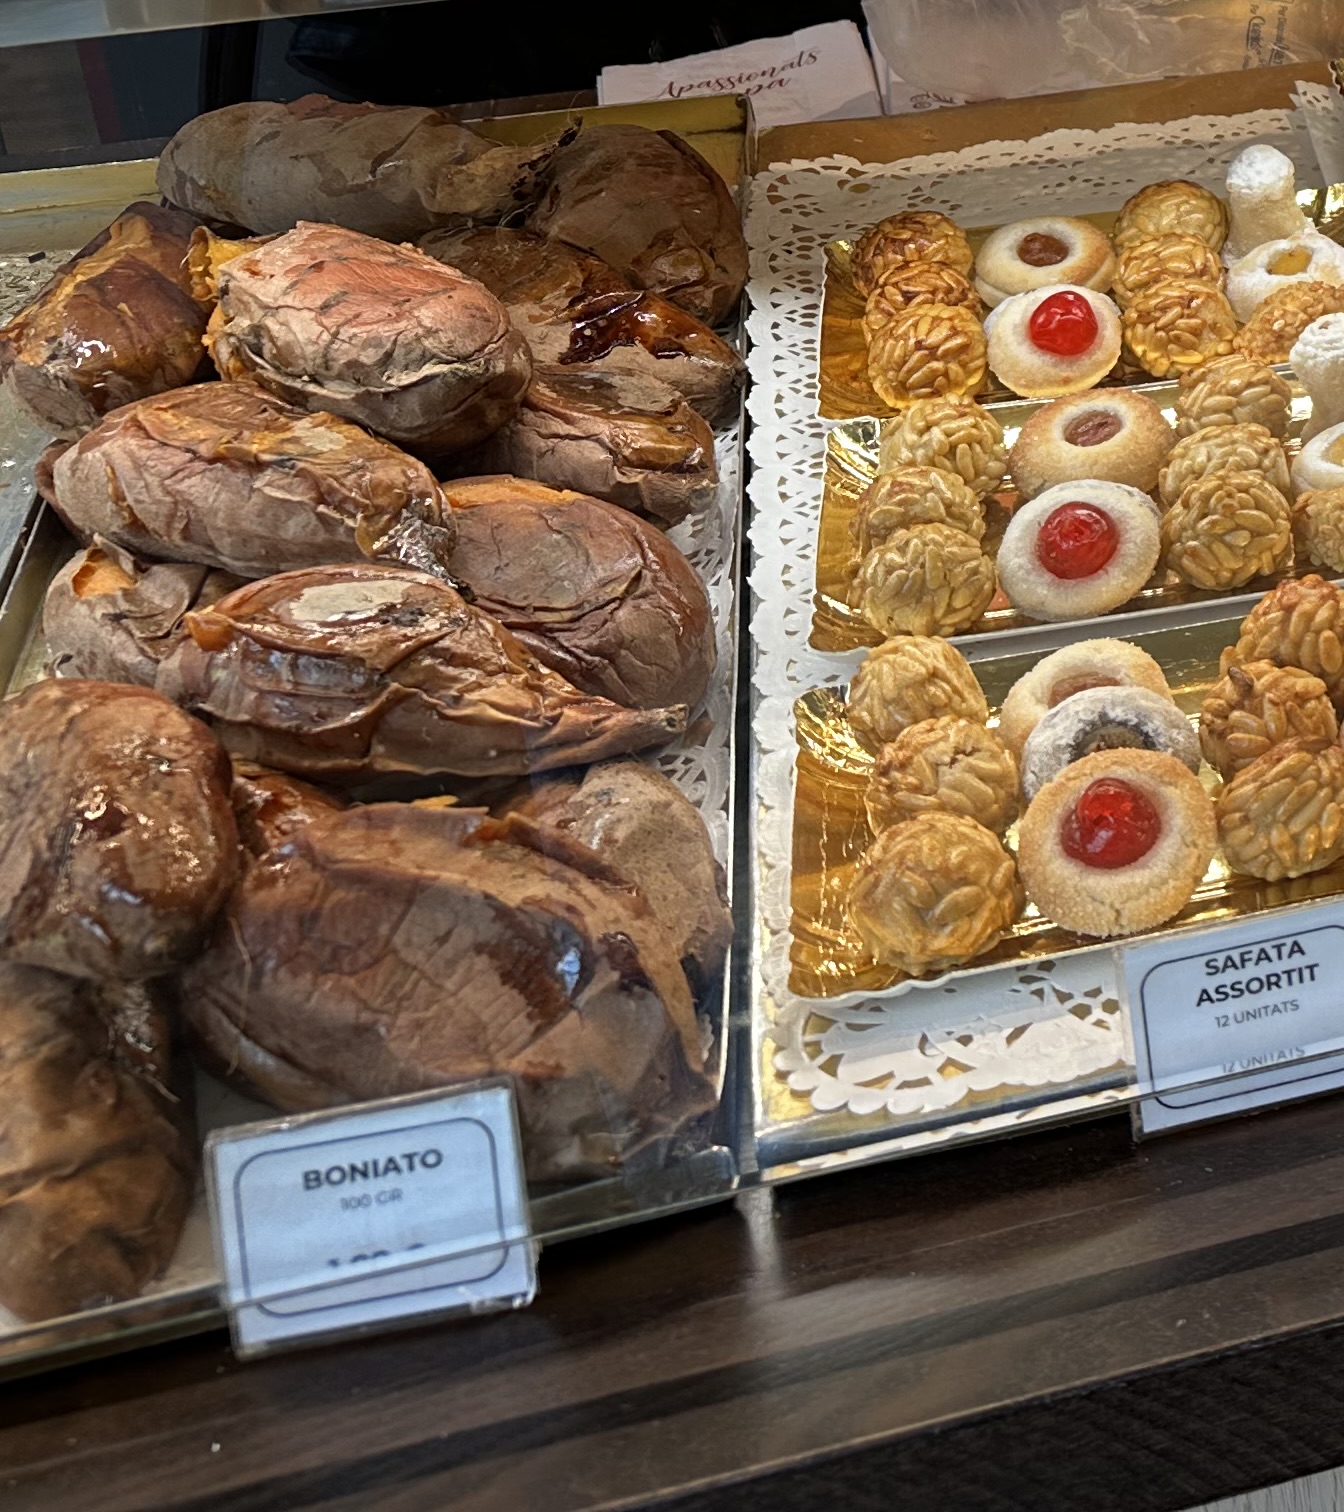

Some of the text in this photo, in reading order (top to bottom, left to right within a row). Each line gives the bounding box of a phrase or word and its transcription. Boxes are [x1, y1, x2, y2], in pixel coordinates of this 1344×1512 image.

[1205, 940, 1306, 976] SAFATA
[1196, 963, 1320, 1007] ASSORTIT
[1215, 999, 1300, 1028] 12 UNITATS
[303, 1148, 444, 1190] BONIATO
